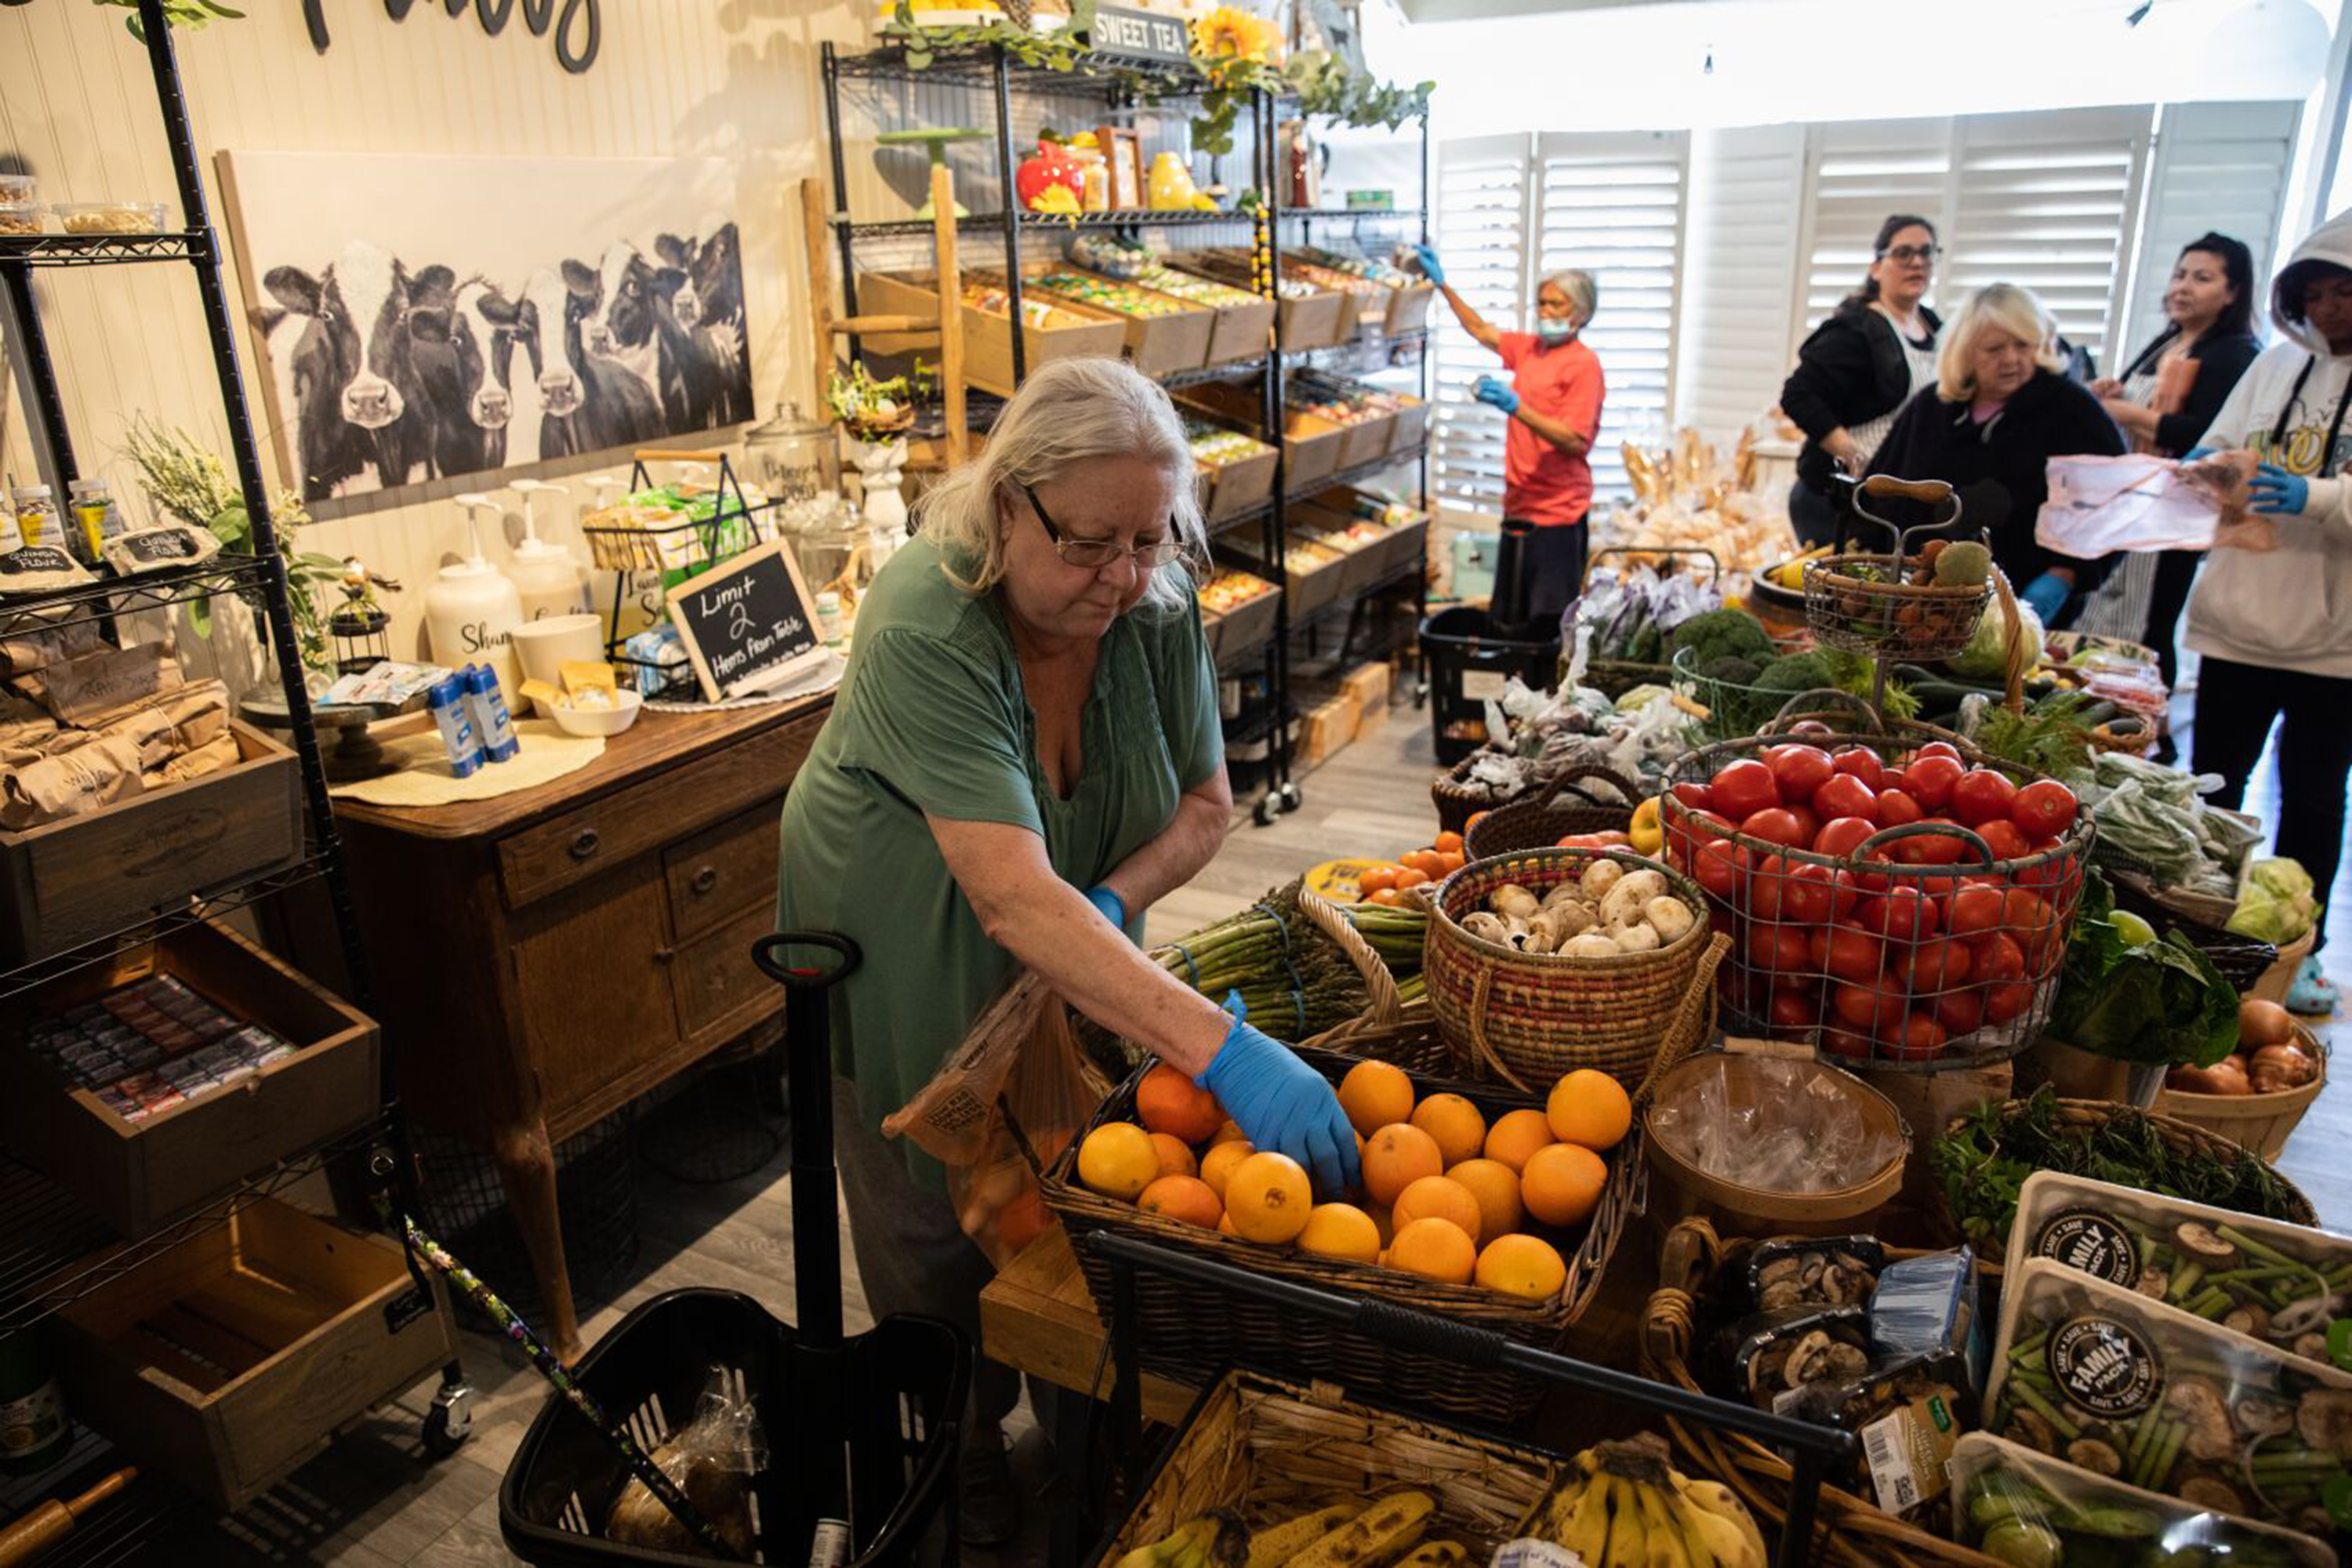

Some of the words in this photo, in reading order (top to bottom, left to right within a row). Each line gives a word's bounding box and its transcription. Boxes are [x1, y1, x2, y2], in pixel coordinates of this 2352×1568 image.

[1094, 13, 1149, 49] SWEET
[1152, 22, 1185, 54] TEA
[701, 575, 756, 618] Limit
[730, 602, 756, 640] 2
[2056, 1350, 2067, 1373] SAVE
[2062, 1326, 2083, 1344] SAVE
[2070, 1338, 2131, 1393] FAMILY
[2089, 1395, 2114, 1409] SAVE
[2122, 1387, 2143, 1405] SAVE
[2136, 1356, 2149, 1380] SAVE
[2094, 1360, 2129, 1390] PACK
